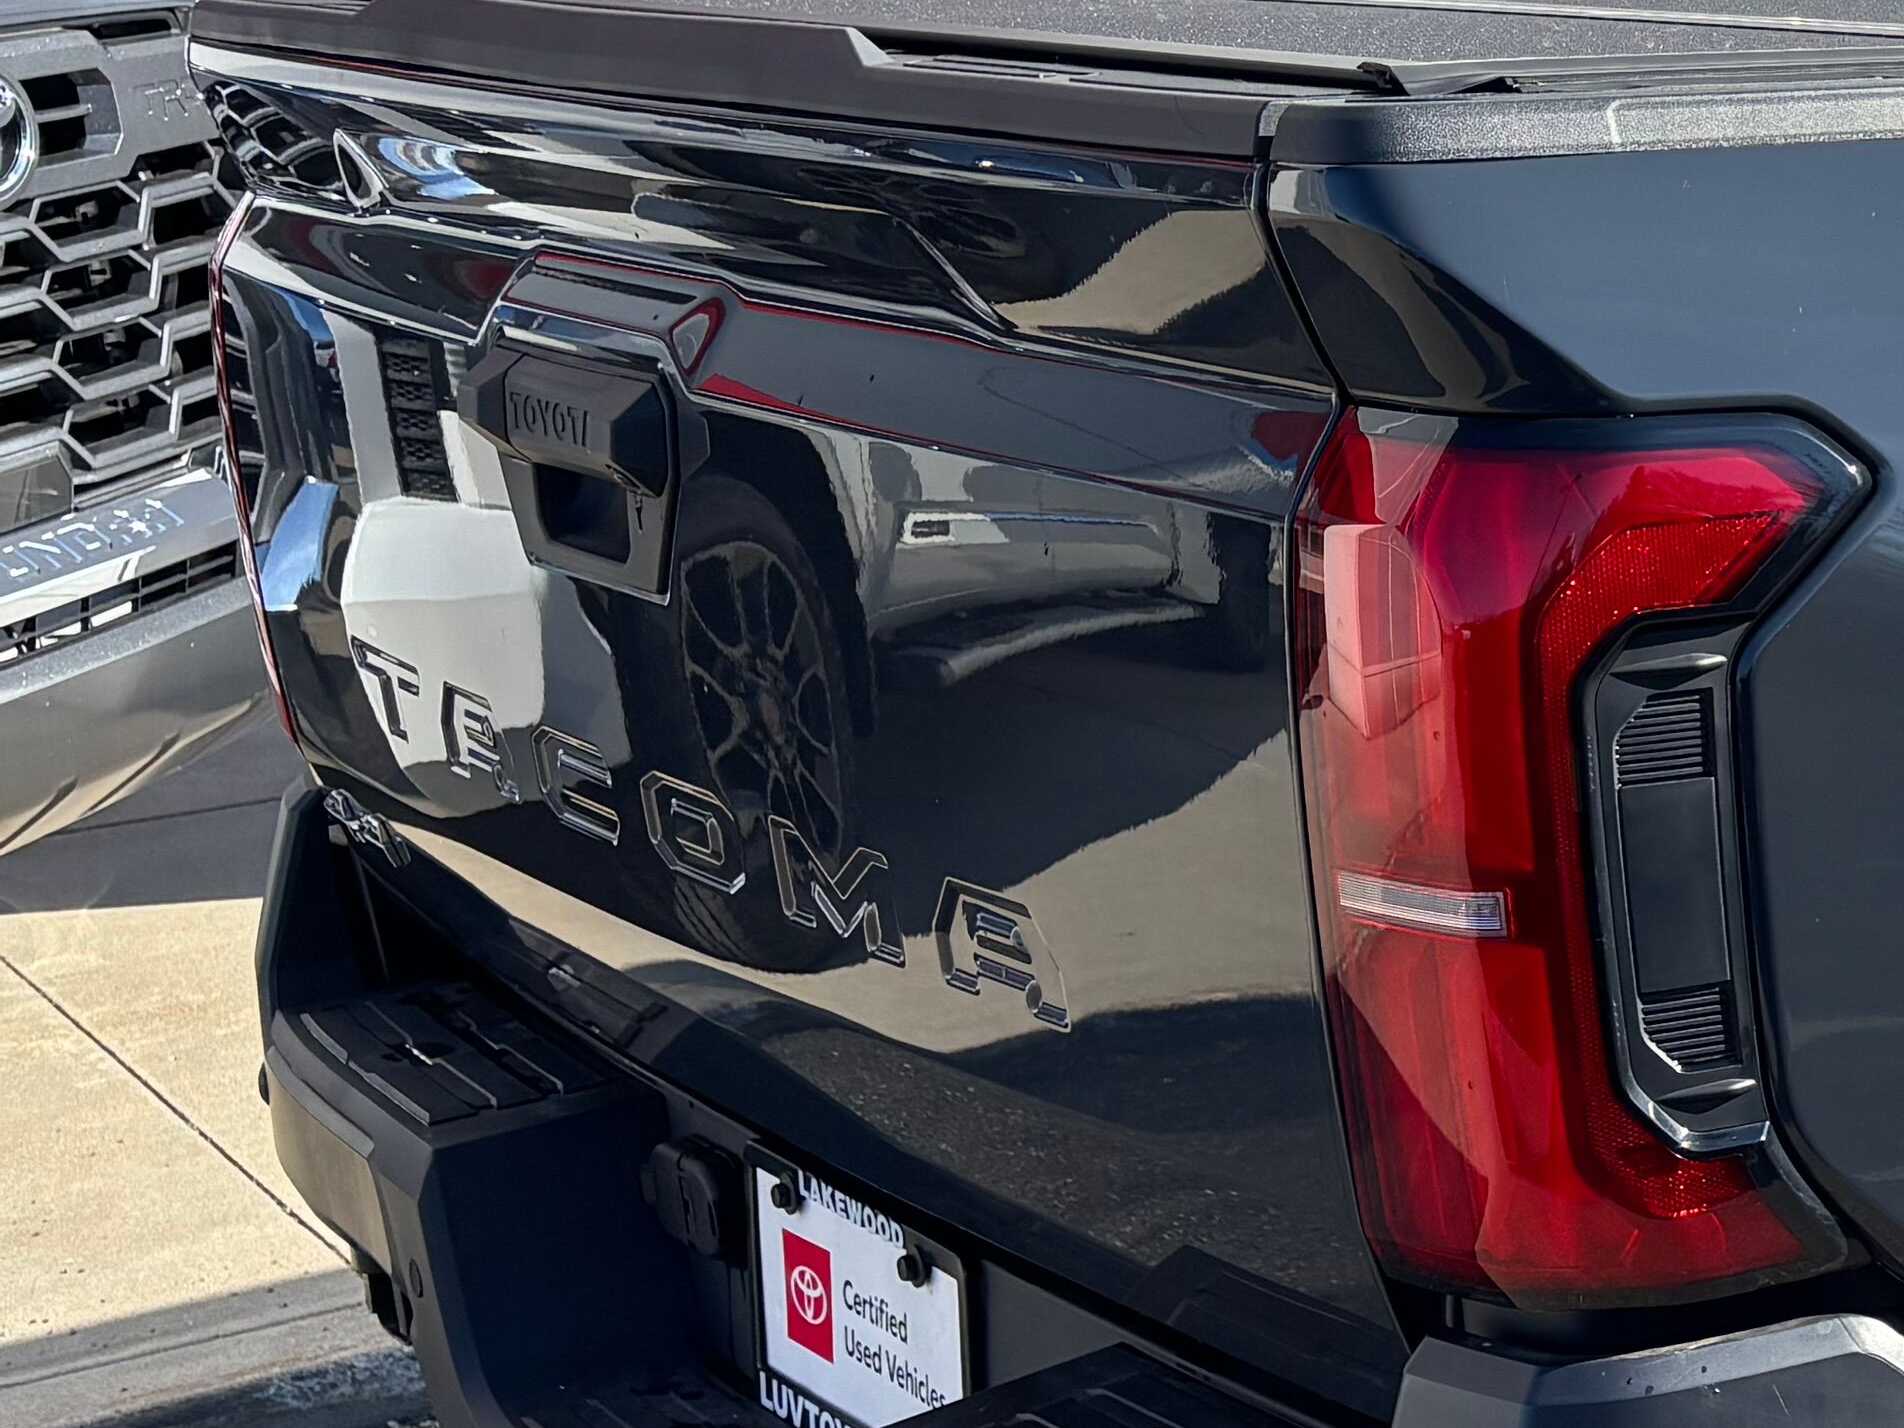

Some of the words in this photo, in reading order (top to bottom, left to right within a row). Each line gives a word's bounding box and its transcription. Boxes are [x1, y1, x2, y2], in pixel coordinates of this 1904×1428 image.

[350, 634, 1071, 1034] TACOMA
[798, 1169, 905, 1250] LAKEWOOD
[843, 1279, 908, 1345] Certified
[844, 1325, 882, 1375] Used
